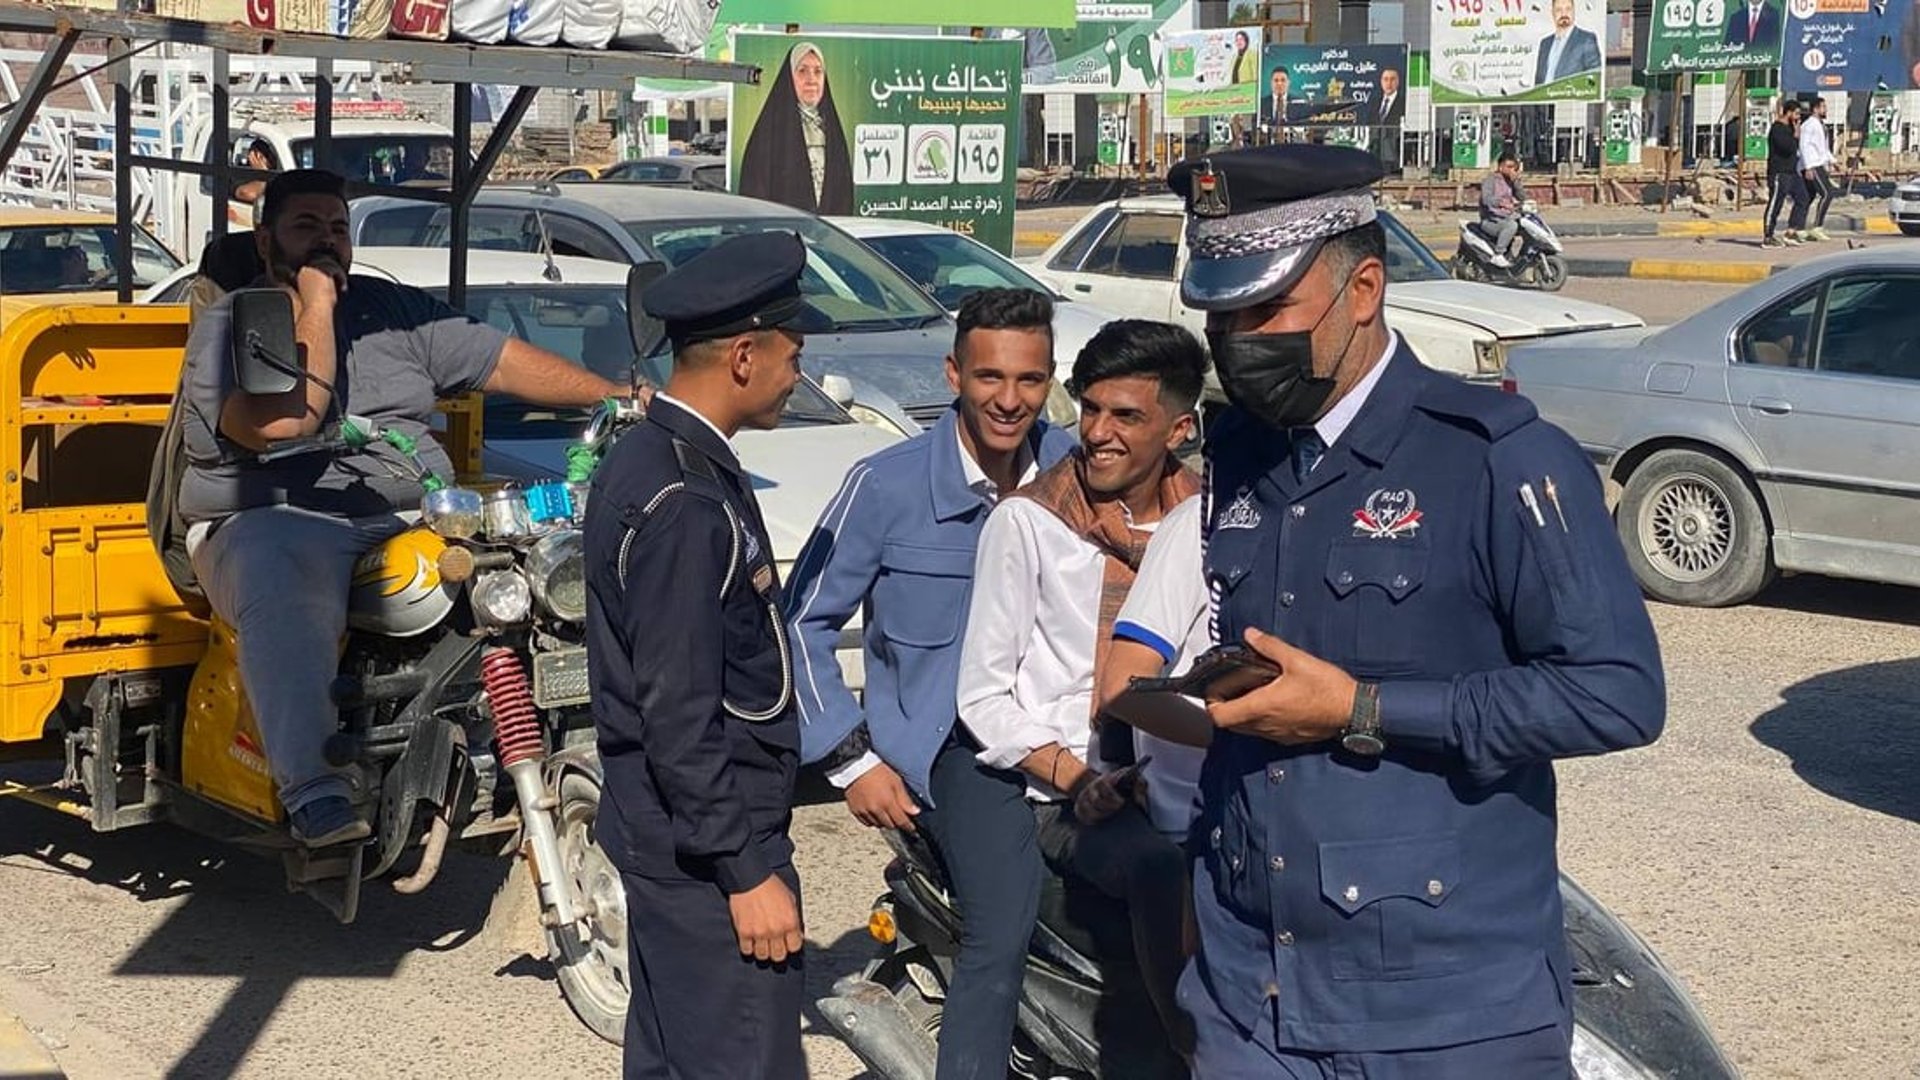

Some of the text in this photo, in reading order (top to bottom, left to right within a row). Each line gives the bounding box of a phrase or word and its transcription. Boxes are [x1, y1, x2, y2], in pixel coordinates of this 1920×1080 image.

[1667, 5, 1692, 21] ١٩٥
[1705, 2, 1714, 22] ٤
[870, 63, 1008, 108] تحالف نبني
[918, 97, 1006, 115] نحميها ونبنيها
[857, 130, 899, 143] التسلسل
[863, 146, 892, 179] ٣١
[961, 144, 1000, 175] ١٩٥
[859, 195, 1003, 216] زهرة عبد الصمد الحسين
